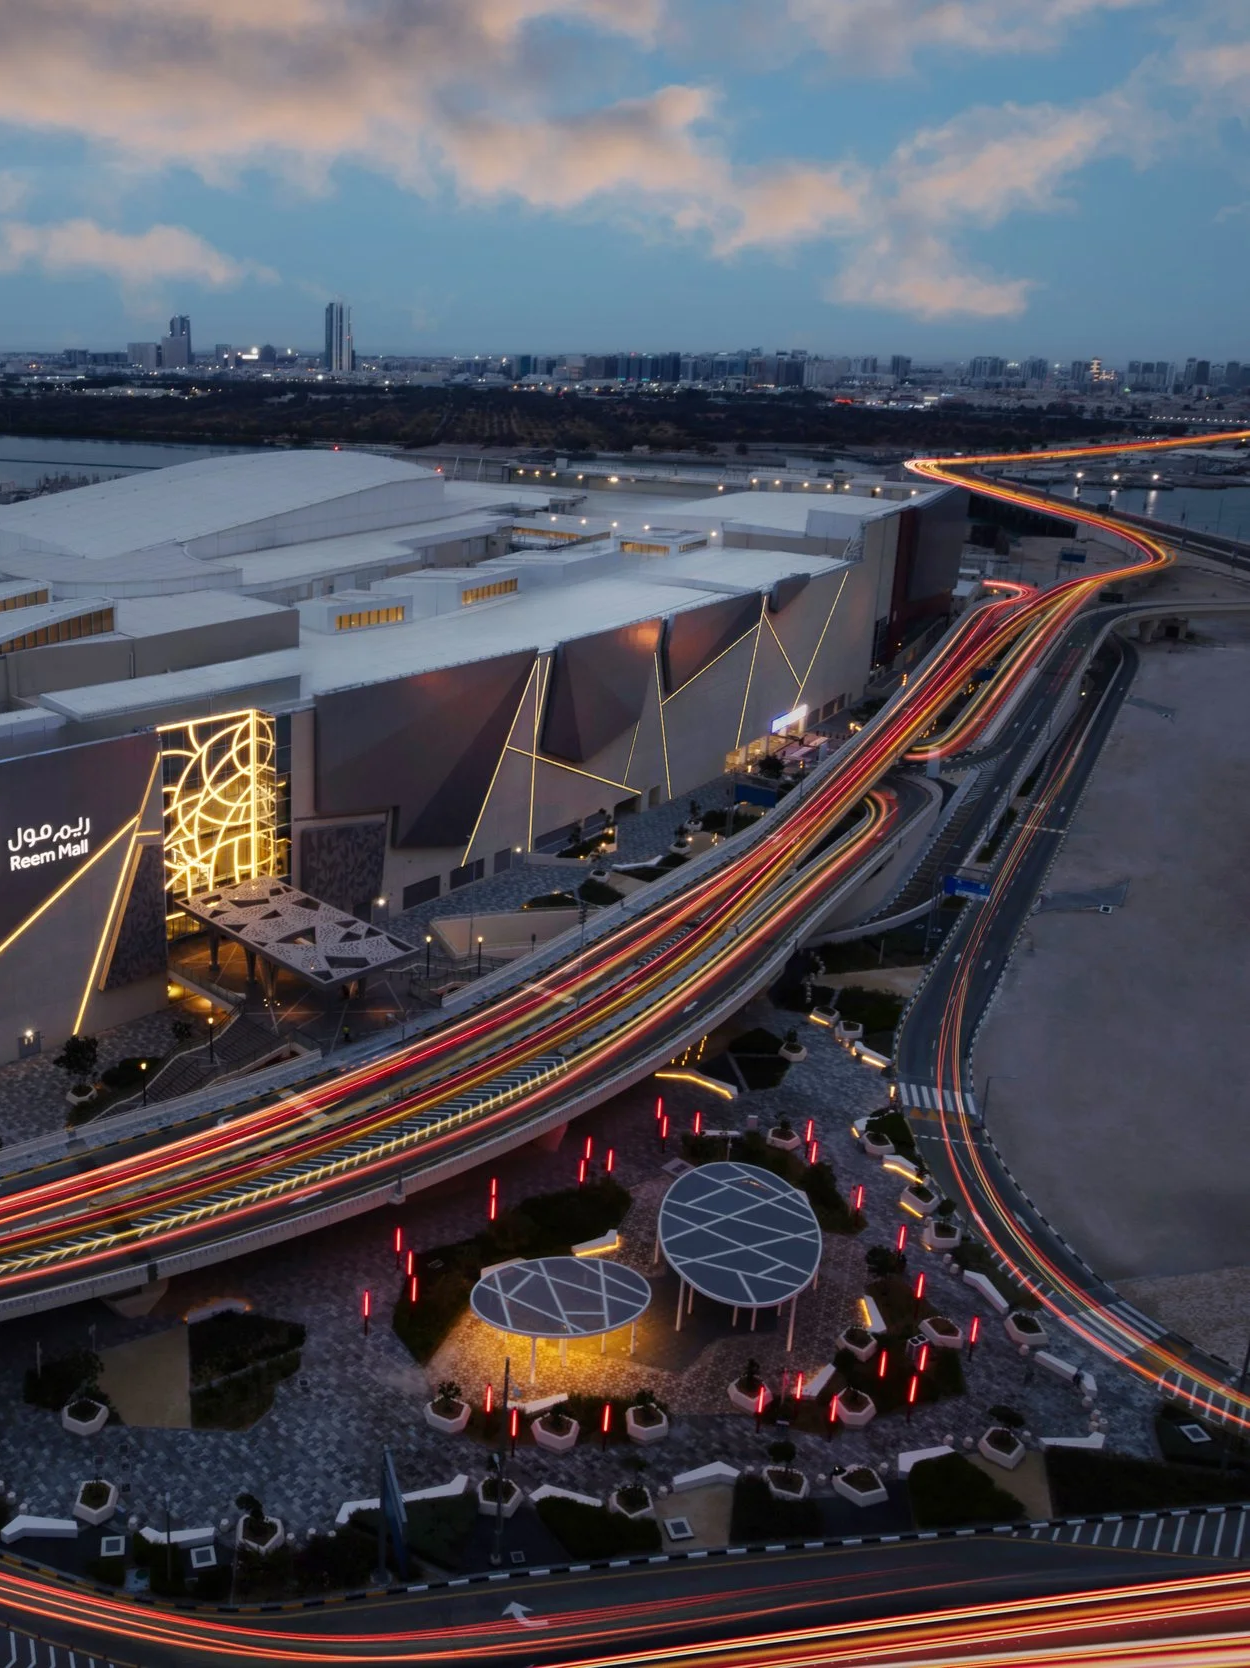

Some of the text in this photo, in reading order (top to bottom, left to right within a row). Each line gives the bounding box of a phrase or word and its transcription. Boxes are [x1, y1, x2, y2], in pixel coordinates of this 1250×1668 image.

[8, 817, 90, 851] ريم مول
[10, 839, 88, 871] Reem Mall
